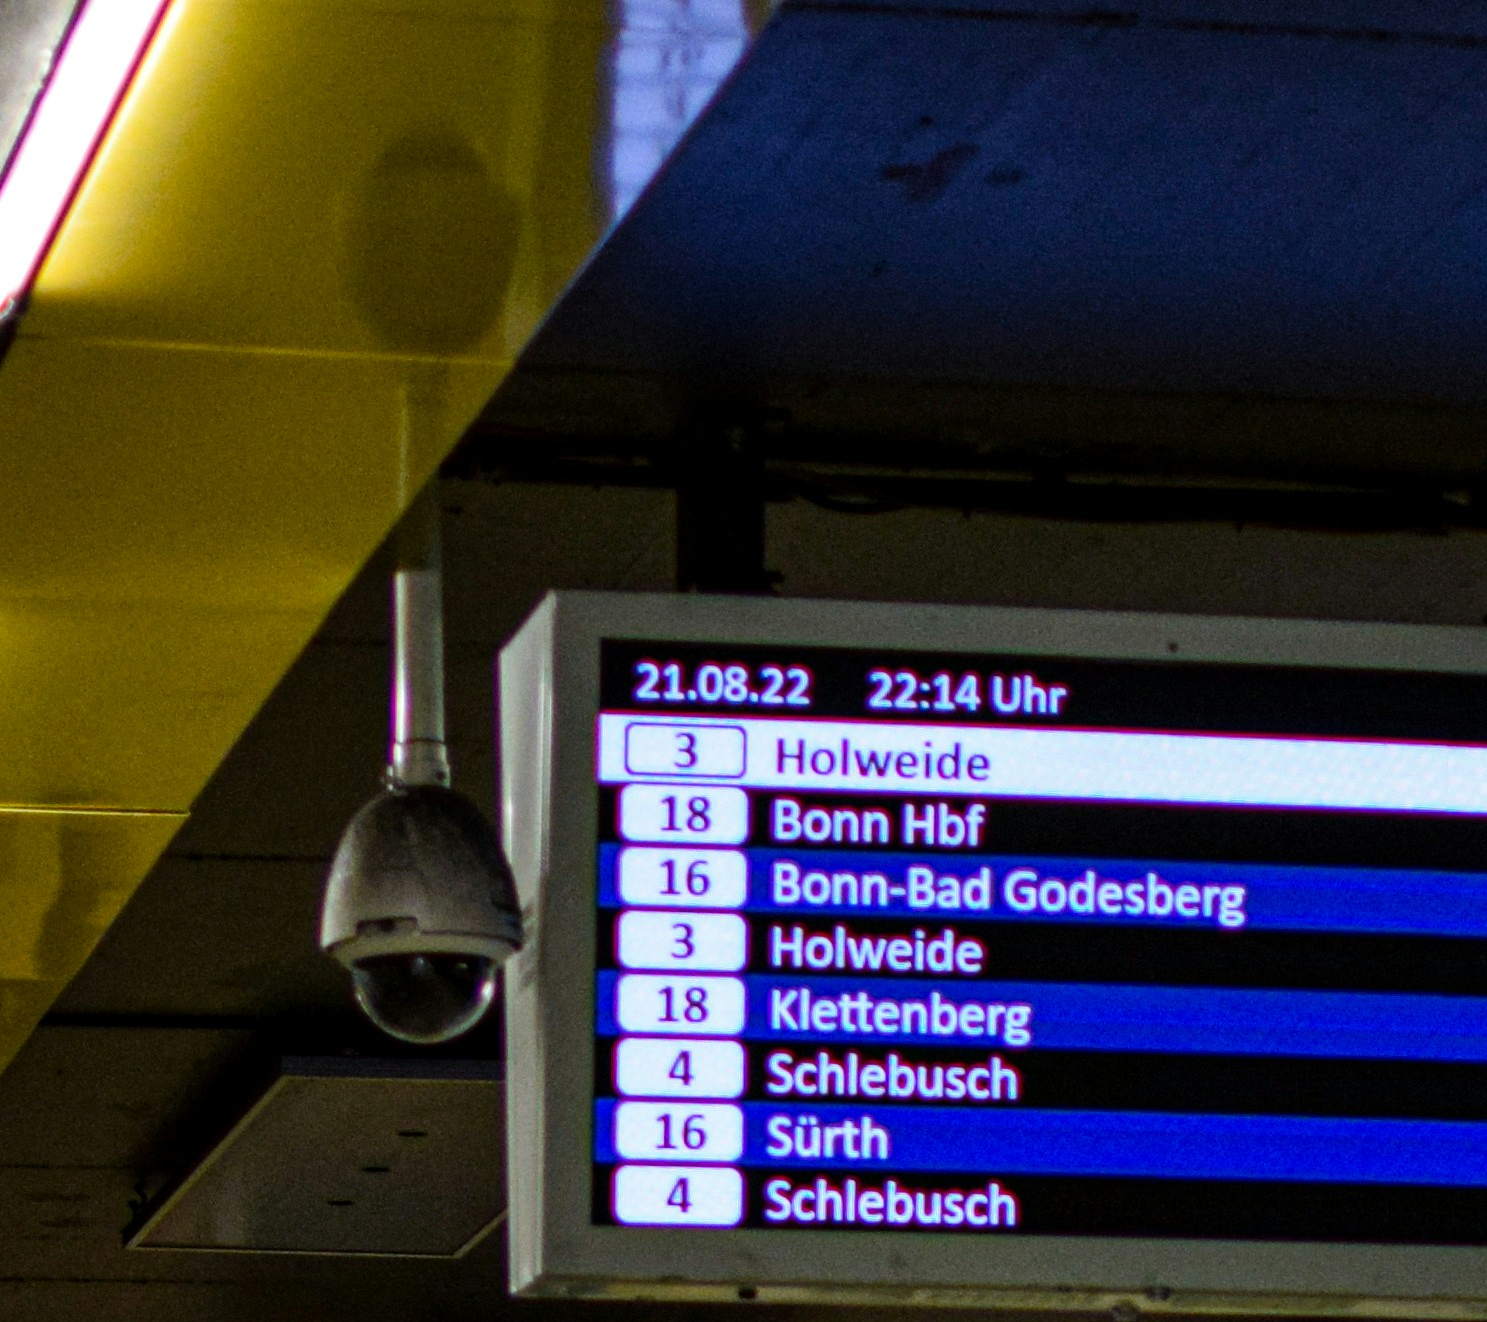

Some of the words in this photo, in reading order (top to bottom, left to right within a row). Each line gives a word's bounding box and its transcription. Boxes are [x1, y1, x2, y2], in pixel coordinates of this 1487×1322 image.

[636, 663, 810, 705] 21.08.22
[869, 671, 981, 711] 22:14
[993, 675, 1067, 714] Uhr
[675, 732, 698, 768] 3
[776, 738, 990, 781] Holweide
[662, 795, 711, 832] 18
[774, 799, 889, 843] Bonn
[904, 803, 986, 846] Hbf
[661, 859, 710, 896] 16
[773, 862, 991, 910] Bonn-Bad
[1004, 870, 1246, 927] Godesberg
[672, 923, 695, 959] 3
[772, 926, 983, 973] Holweide
[659, 986, 709, 1023] 18
[771, 988, 1032, 1046] Klettenberg
[668, 1050, 693, 1086] 4
[768, 1052, 1017, 1100] Schlebusch
[657, 1113, 707, 1150] 16
[766, 1116, 888, 1160] Sürth
[666, 1177, 692, 1213] 4
[766, 1179, 1015, 1226] Schlebusch
